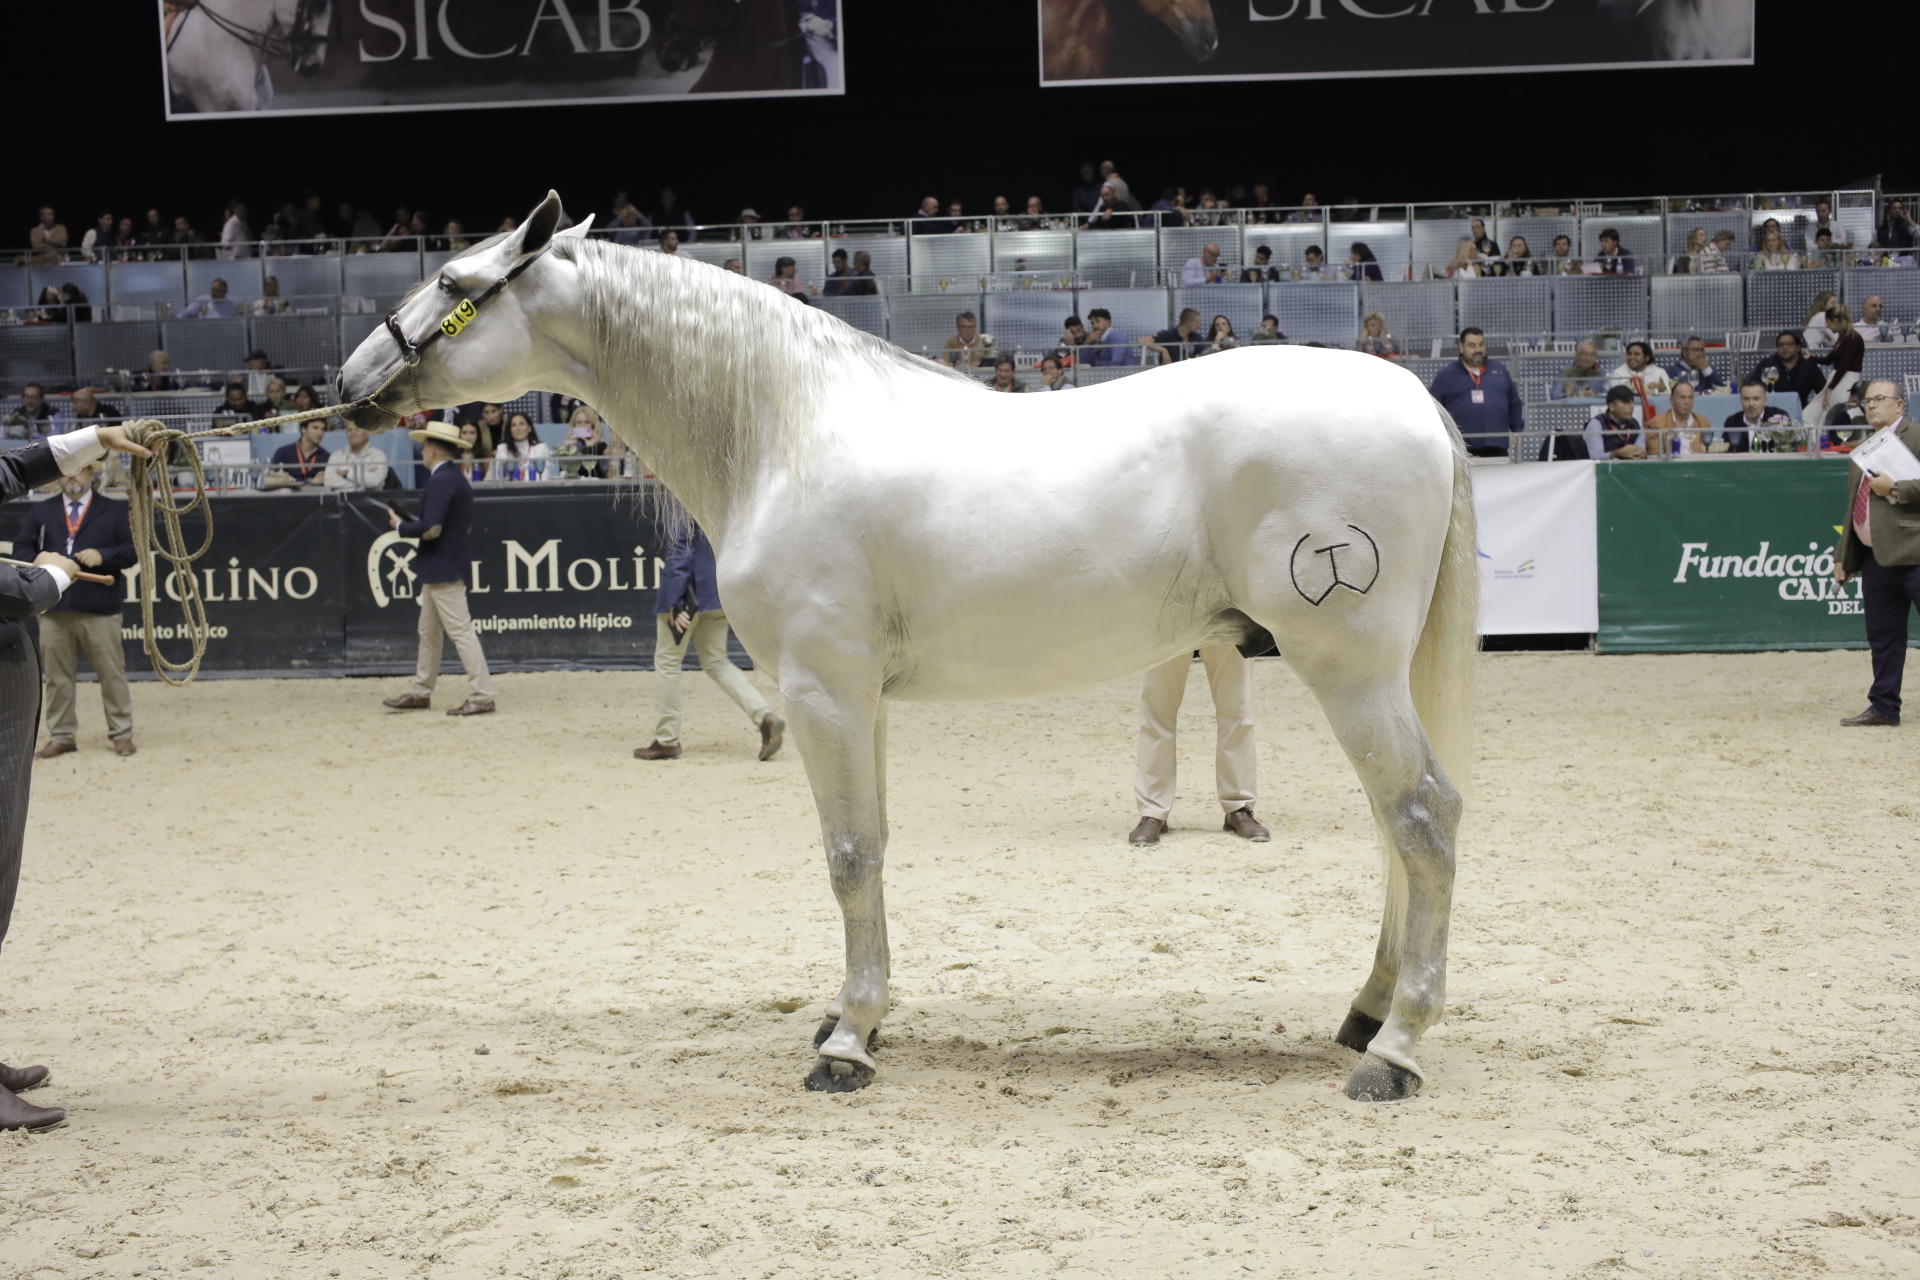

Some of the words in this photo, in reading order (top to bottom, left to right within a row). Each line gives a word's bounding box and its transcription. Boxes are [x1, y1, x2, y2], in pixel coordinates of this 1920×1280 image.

[358, 0, 652, 62] SICAB
[442, 301, 474, 335] 819
[1673, 541, 1836, 583] Fundació
[471, 614, 576, 634] quipamiento
[579, 612, 632, 632] Hípico
[1828, 600, 1865, 615] DEL
